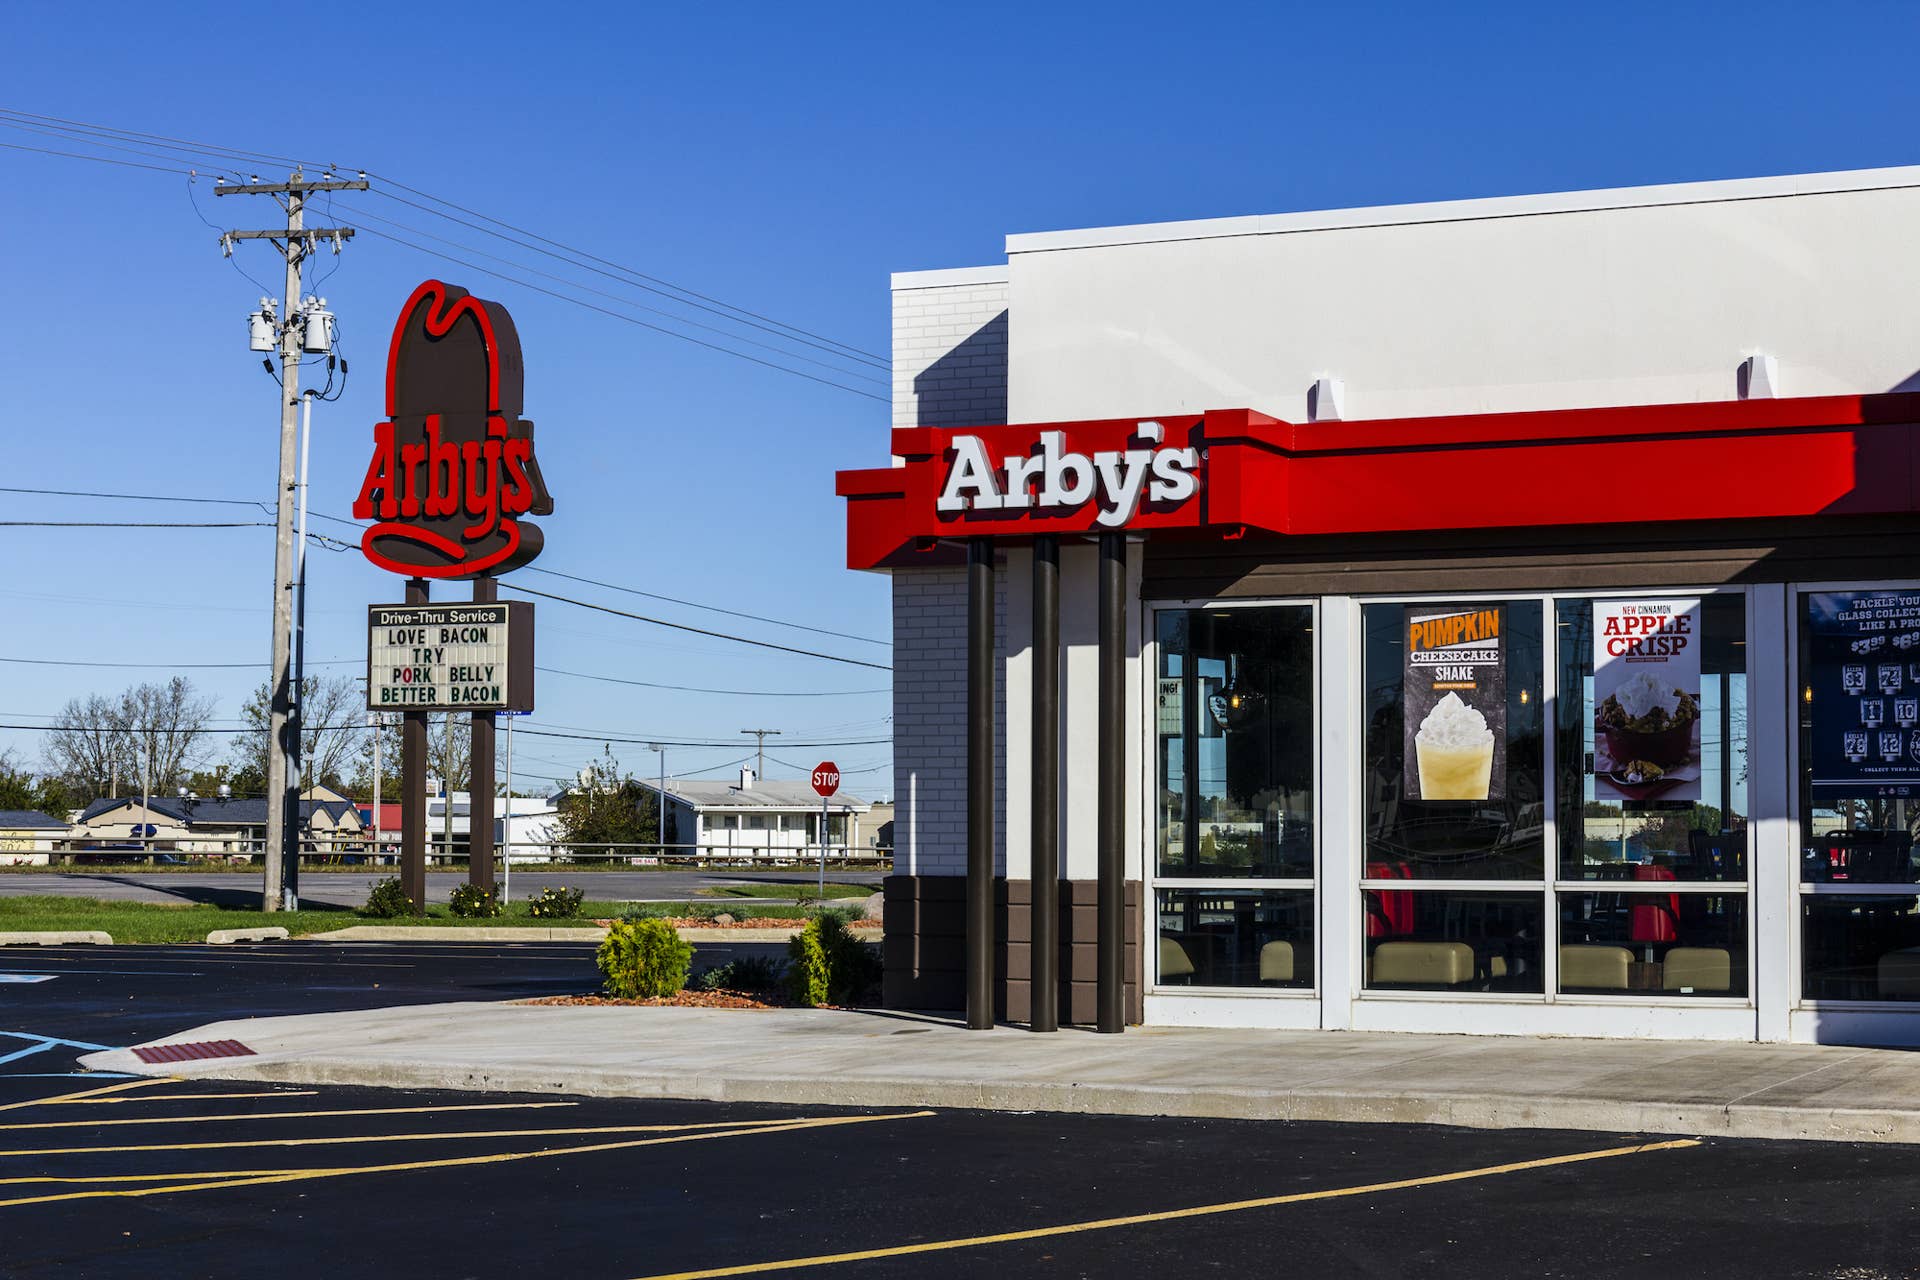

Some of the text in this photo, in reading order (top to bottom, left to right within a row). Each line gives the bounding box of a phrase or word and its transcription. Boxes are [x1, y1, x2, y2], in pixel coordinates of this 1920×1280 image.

[353, 414, 533, 539] Arby's
[937, 421, 1199, 527] Arby's
[1622, 605, 1671, 615] NEW CINNAMON
[1853, 598, 1895, 609] TACKLE
[380, 610, 496, 624] Drive-Thru Service
[1838, 610, 1872, 621] GLASS
[1410, 609, 1499, 652] PUMPKIN
[1603, 615, 1691, 636] APPLE
[1859, 621, 1886, 631] LIKE
[1889, 620, 1897, 629] A
[389, 628, 488, 645] LOVE BACON
[1607, 636, 1687, 657] CRISP
[413, 648, 444, 663] TRY
[1411, 650, 1498, 662] CHEESECAKE
[393, 666, 494, 683] PORK BELLY
[1436, 667, 1474, 681] SHAKE
[1882, 671, 1899, 686] 74
[381, 686, 499, 702] BETTER BACON
[1899, 704, 1914, 719] 10
[1883, 738, 1899, 753] 12
[814, 772, 838, 787] STOP
